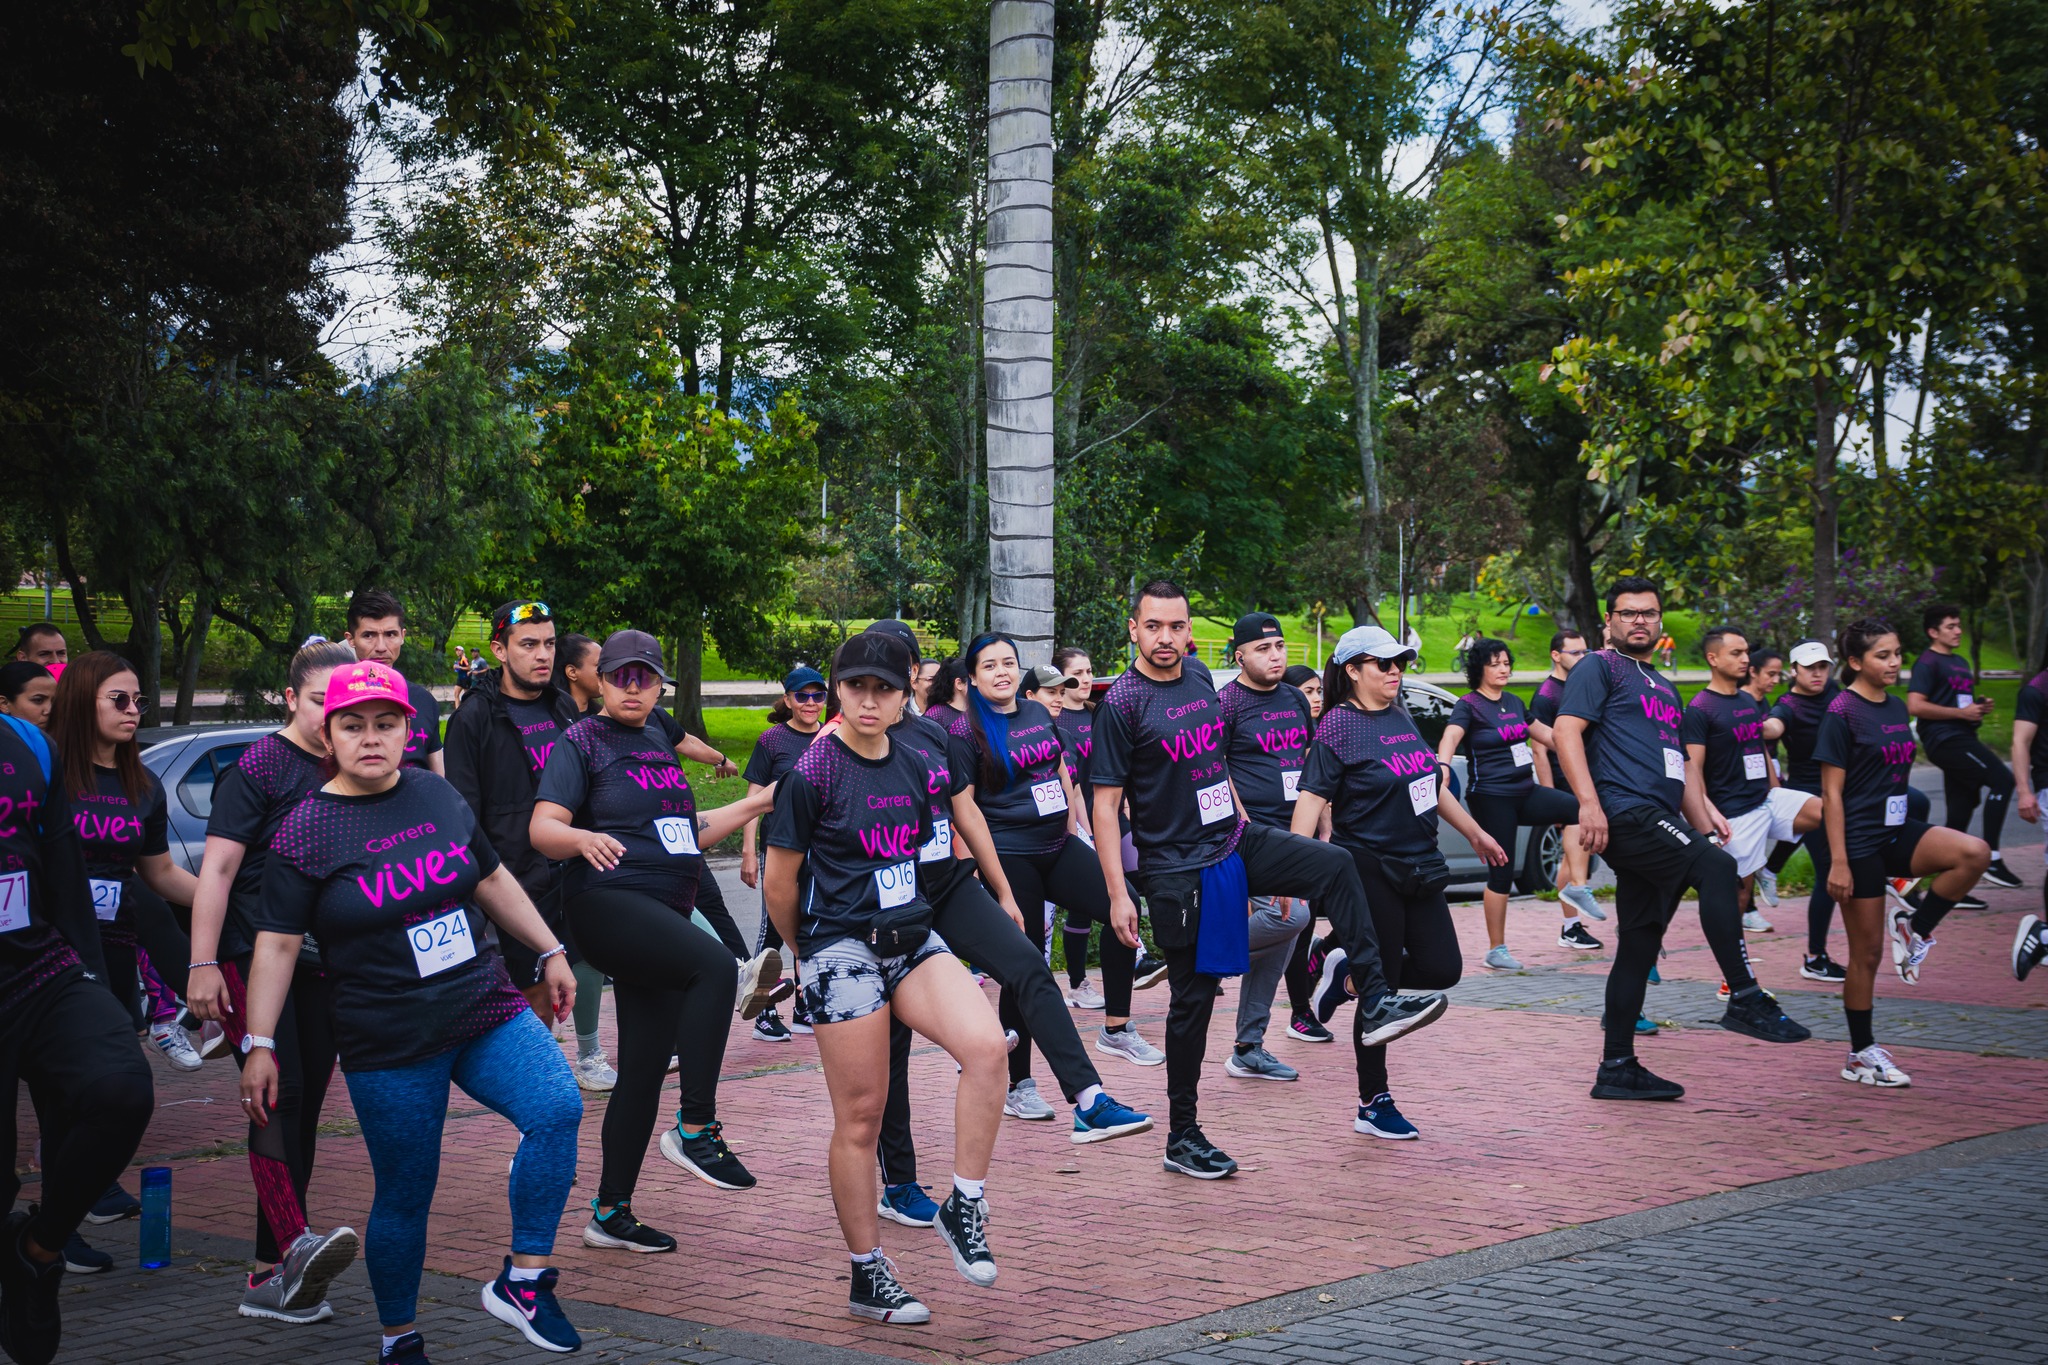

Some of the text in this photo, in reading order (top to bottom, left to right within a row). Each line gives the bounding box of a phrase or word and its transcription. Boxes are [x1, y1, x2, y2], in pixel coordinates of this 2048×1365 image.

[1166, 699, 1208, 720] Carrera
[1262, 710, 1297, 721] Carrera
[1010, 725, 1045, 738] Carrera
[1380, 733, 1417, 745] Carrera
[631, 751, 673, 761] Carrera
[1190, 761, 1223, 781] 3k y 5k
[77, 790, 128, 806] Carrera
[1034, 783, 1062, 803] 059
[1200, 785, 1230, 811] 088
[1411, 778, 1434, 802] 057
[661, 800, 693, 812] 3k y 5k
[867, 794, 911, 810] Carrera
[365, 822, 437, 853] Carrera
[662, 823, 690, 843] 017
[922, 823, 949, 849] 15
[879, 861, 914, 890] 016
[0, 875, 26, 911] 71
[94, 884, 117, 908] 21
[403, 898, 459, 926] 3k y 5k
[413, 914, 466, 953] 024
